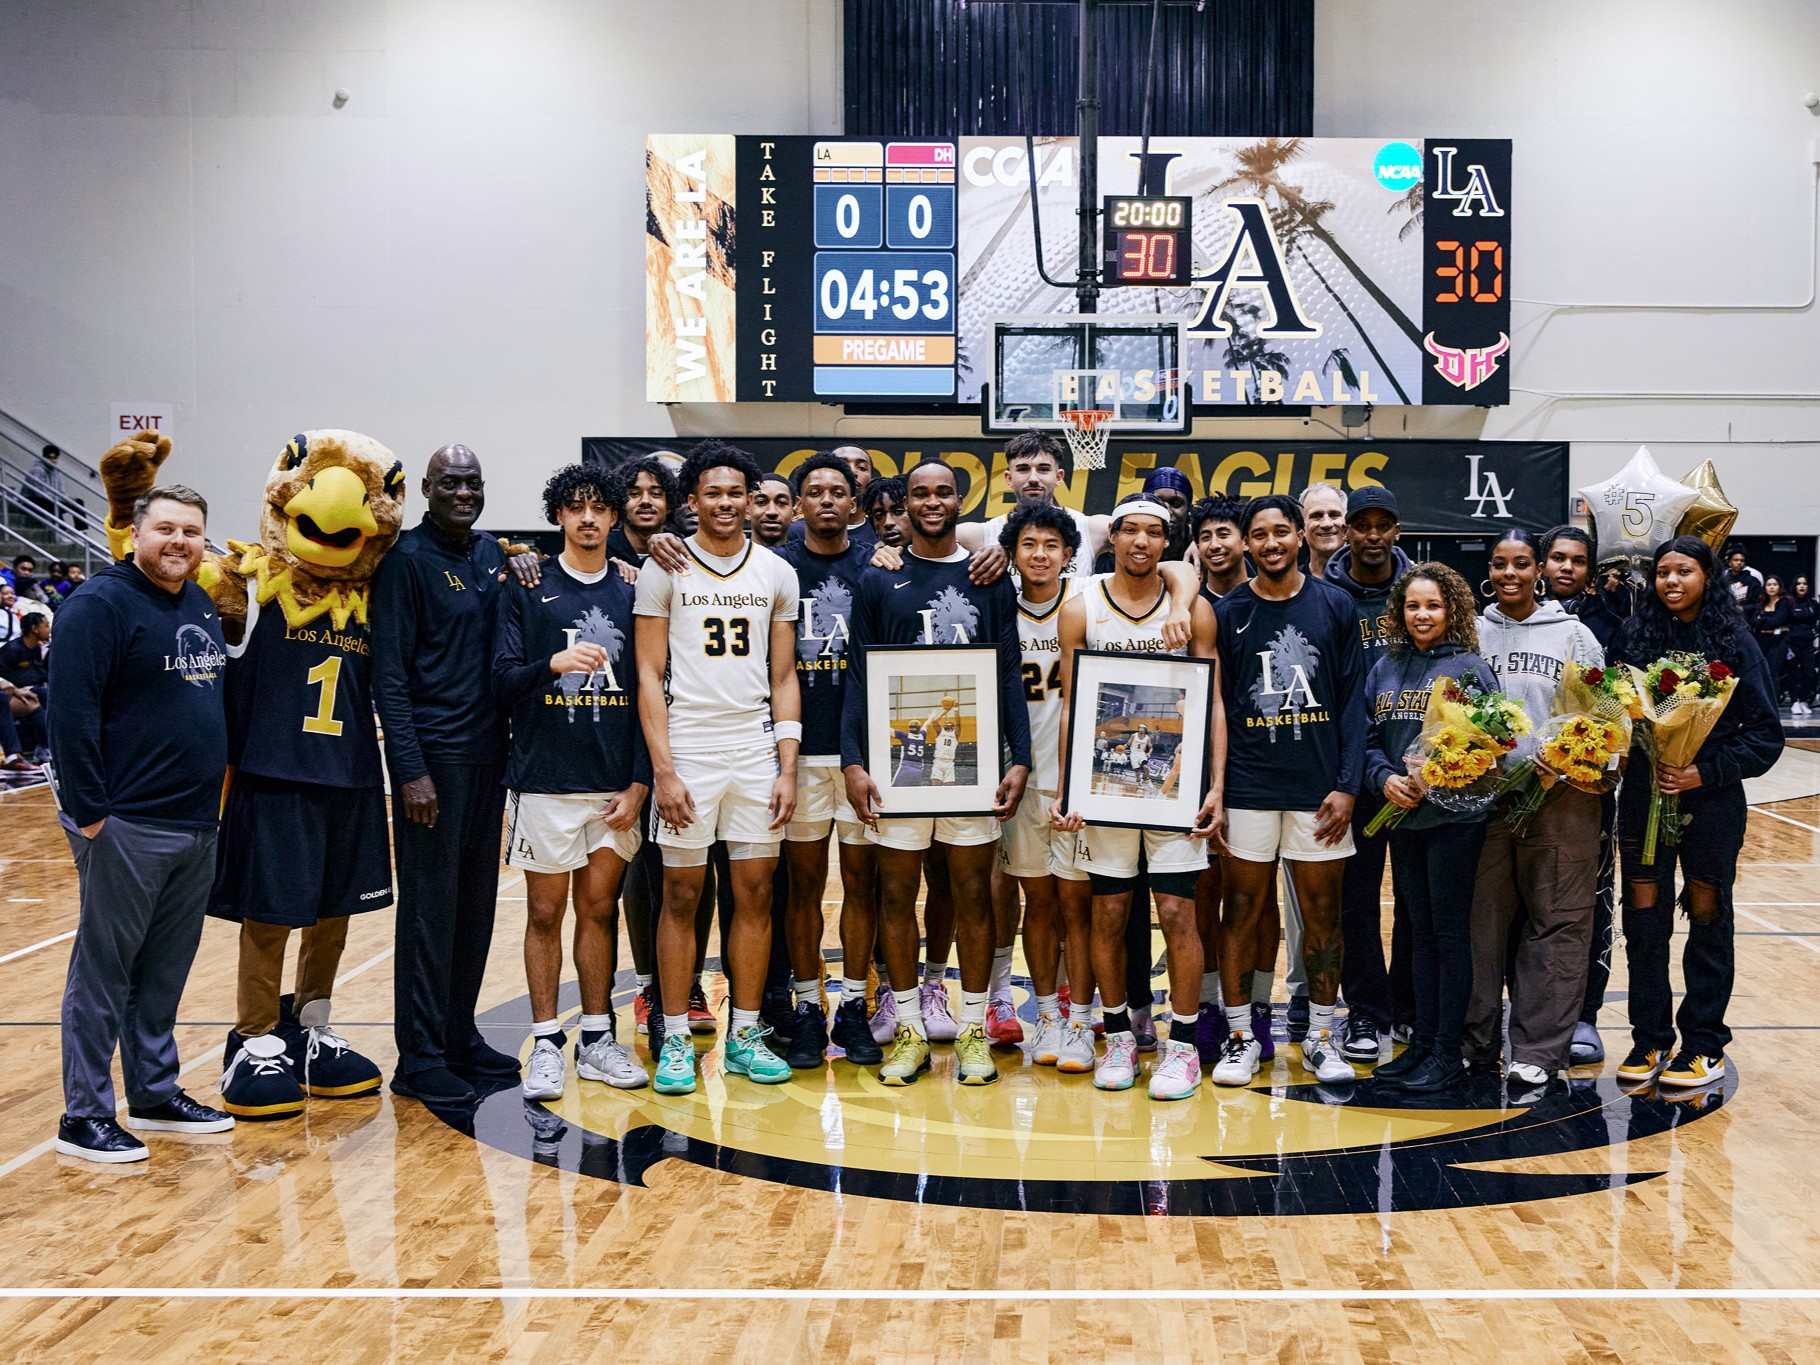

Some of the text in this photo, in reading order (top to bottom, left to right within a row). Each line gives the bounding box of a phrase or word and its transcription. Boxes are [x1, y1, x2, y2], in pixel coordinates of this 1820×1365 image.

[817, 148, 832, 160] LA
[934, 148, 953, 162] DH
[1378, 165, 1421, 179] NCAA
[1432, 147, 1505, 217] LA
[836, 194, 860, 239] 0
[908, 194, 932, 239] 0
[1114, 202, 1182, 226] 20:00
[675, 150, 707, 384] WE ARE LA
[1123, 234, 1175, 277] 30
[760, 142, 777, 397] TAKE FLIGHT
[1435, 241, 1502, 303] 30
[820, 269, 949, 321] 04:53
[842, 339, 926, 361] PREGAME
[119, 415, 162, 430] EXIT
[1464, 454, 1515, 517] LA
[443, 570, 467, 591] LA
[681, 593, 768, 609] Los Angeles
[284, 627, 317, 642] Los
[702, 616, 751, 658] 33
[164, 651, 227, 671] Los Angeles
[1507, 652, 1565, 684] STATE
[1020, 660, 1063, 701] 24
[1256, 650, 1322, 710] LA
[302, 655, 344, 737] 1
[1246, 711, 1330, 727] BASKETBALL
[907, 744, 925, 757] 55
[518, 838, 536, 860] LA
[1078, 840, 1093, 861] LA
[360, 889, 388, 900] GOLDEN
